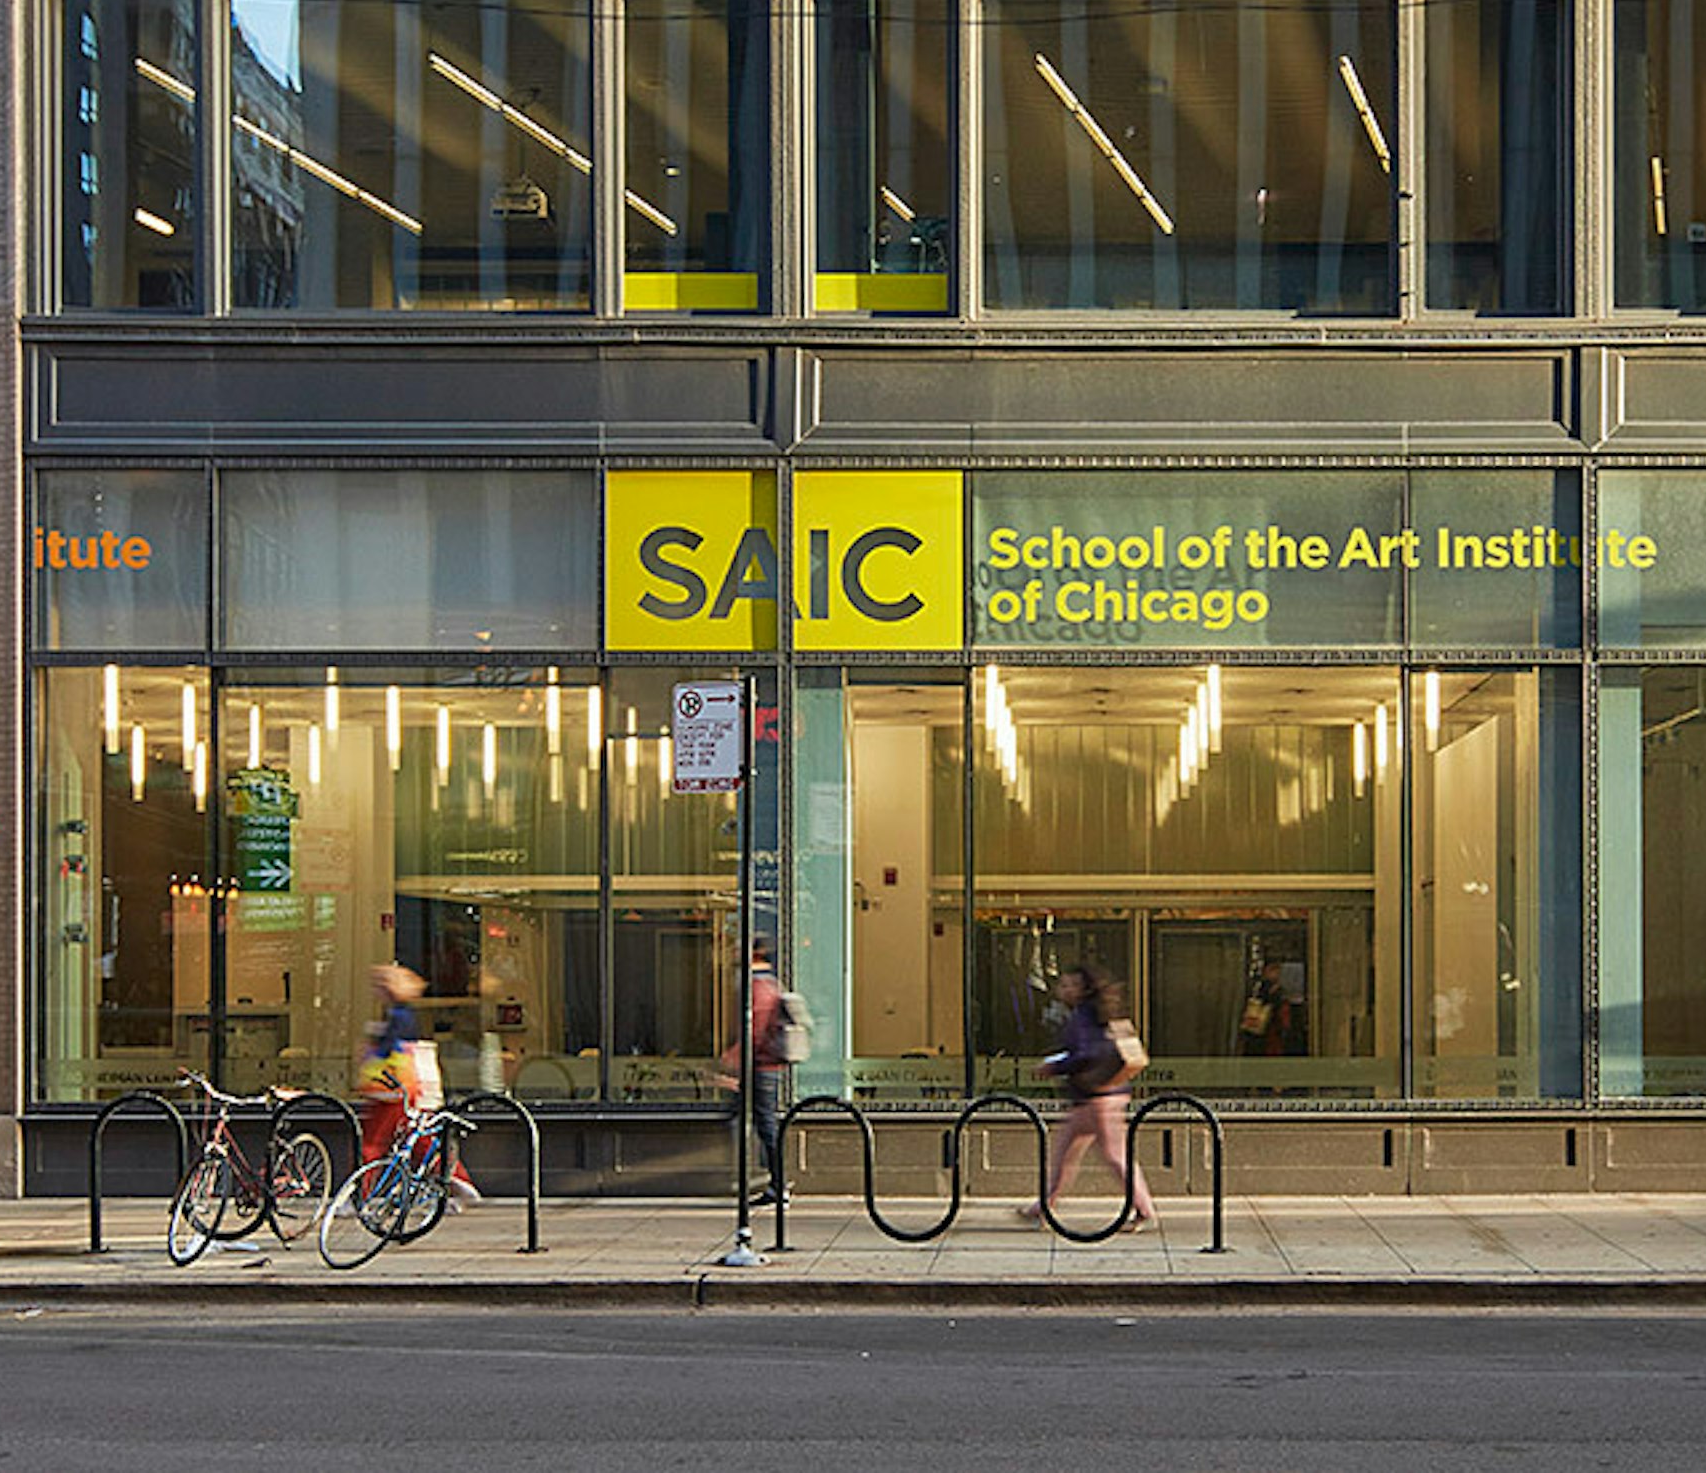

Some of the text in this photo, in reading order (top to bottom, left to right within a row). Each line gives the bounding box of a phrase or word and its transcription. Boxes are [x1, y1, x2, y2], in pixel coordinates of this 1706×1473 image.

[988, 525, 1657, 570] School of the Art Institute
[637, 526, 925, 623] SAIC
[987, 579, 1269, 631] of Chicago
